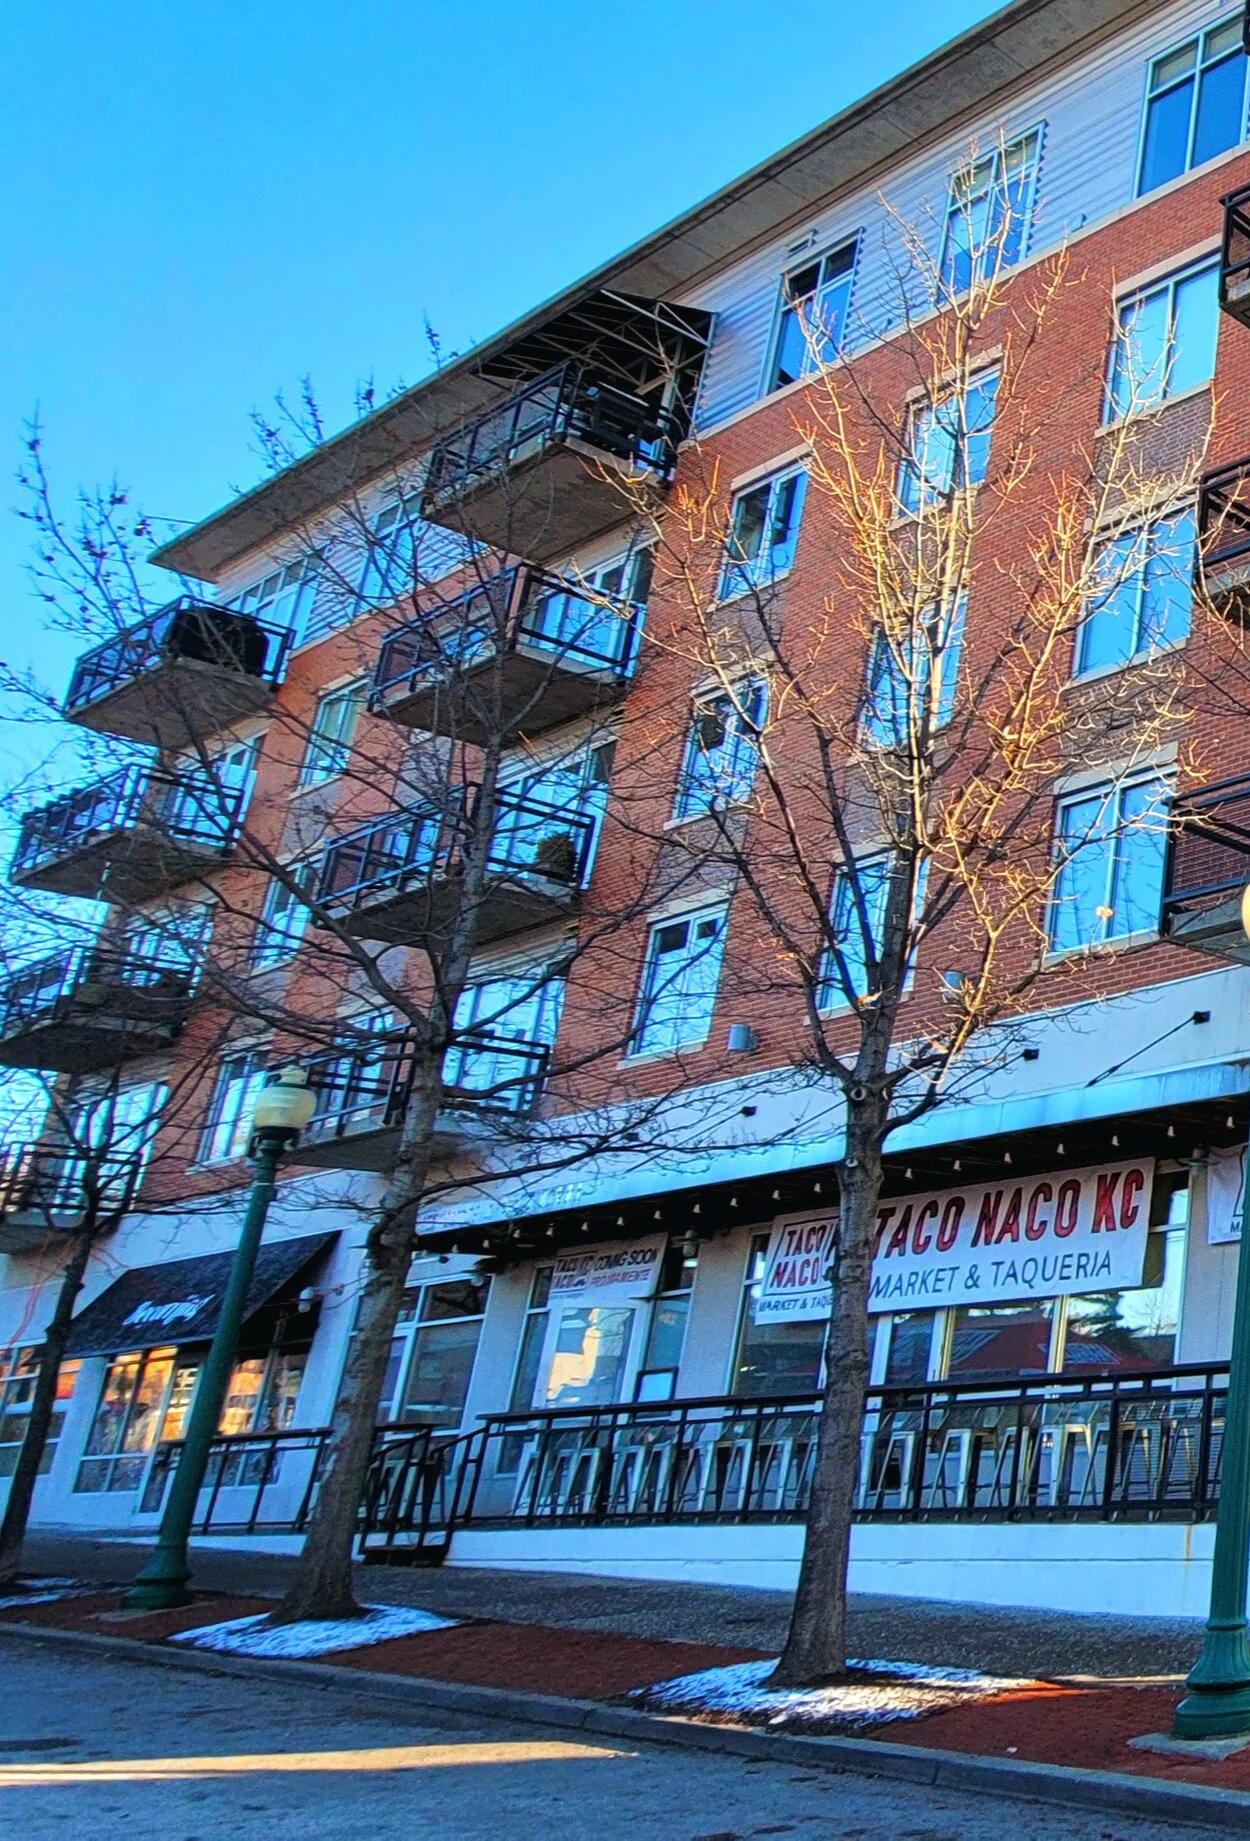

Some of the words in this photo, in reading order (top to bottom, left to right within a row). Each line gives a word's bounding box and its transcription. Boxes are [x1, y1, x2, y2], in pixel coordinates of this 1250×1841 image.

[870, 1196, 965, 1260] TACO
[970, 1187, 1083, 1248] NACO
[1091, 1168, 1145, 1233] KC
[784, 1224, 828, 1257] TACO
[627, 1248, 659, 1266] SOON
[769, 1257, 820, 1288] NACO
[869, 1266, 960, 1299] MARKET
[964, 1264, 980, 1289] &
[991, 1249, 1112, 1287] TAQUERIA
[758, 1299, 800, 1313] MARKET
